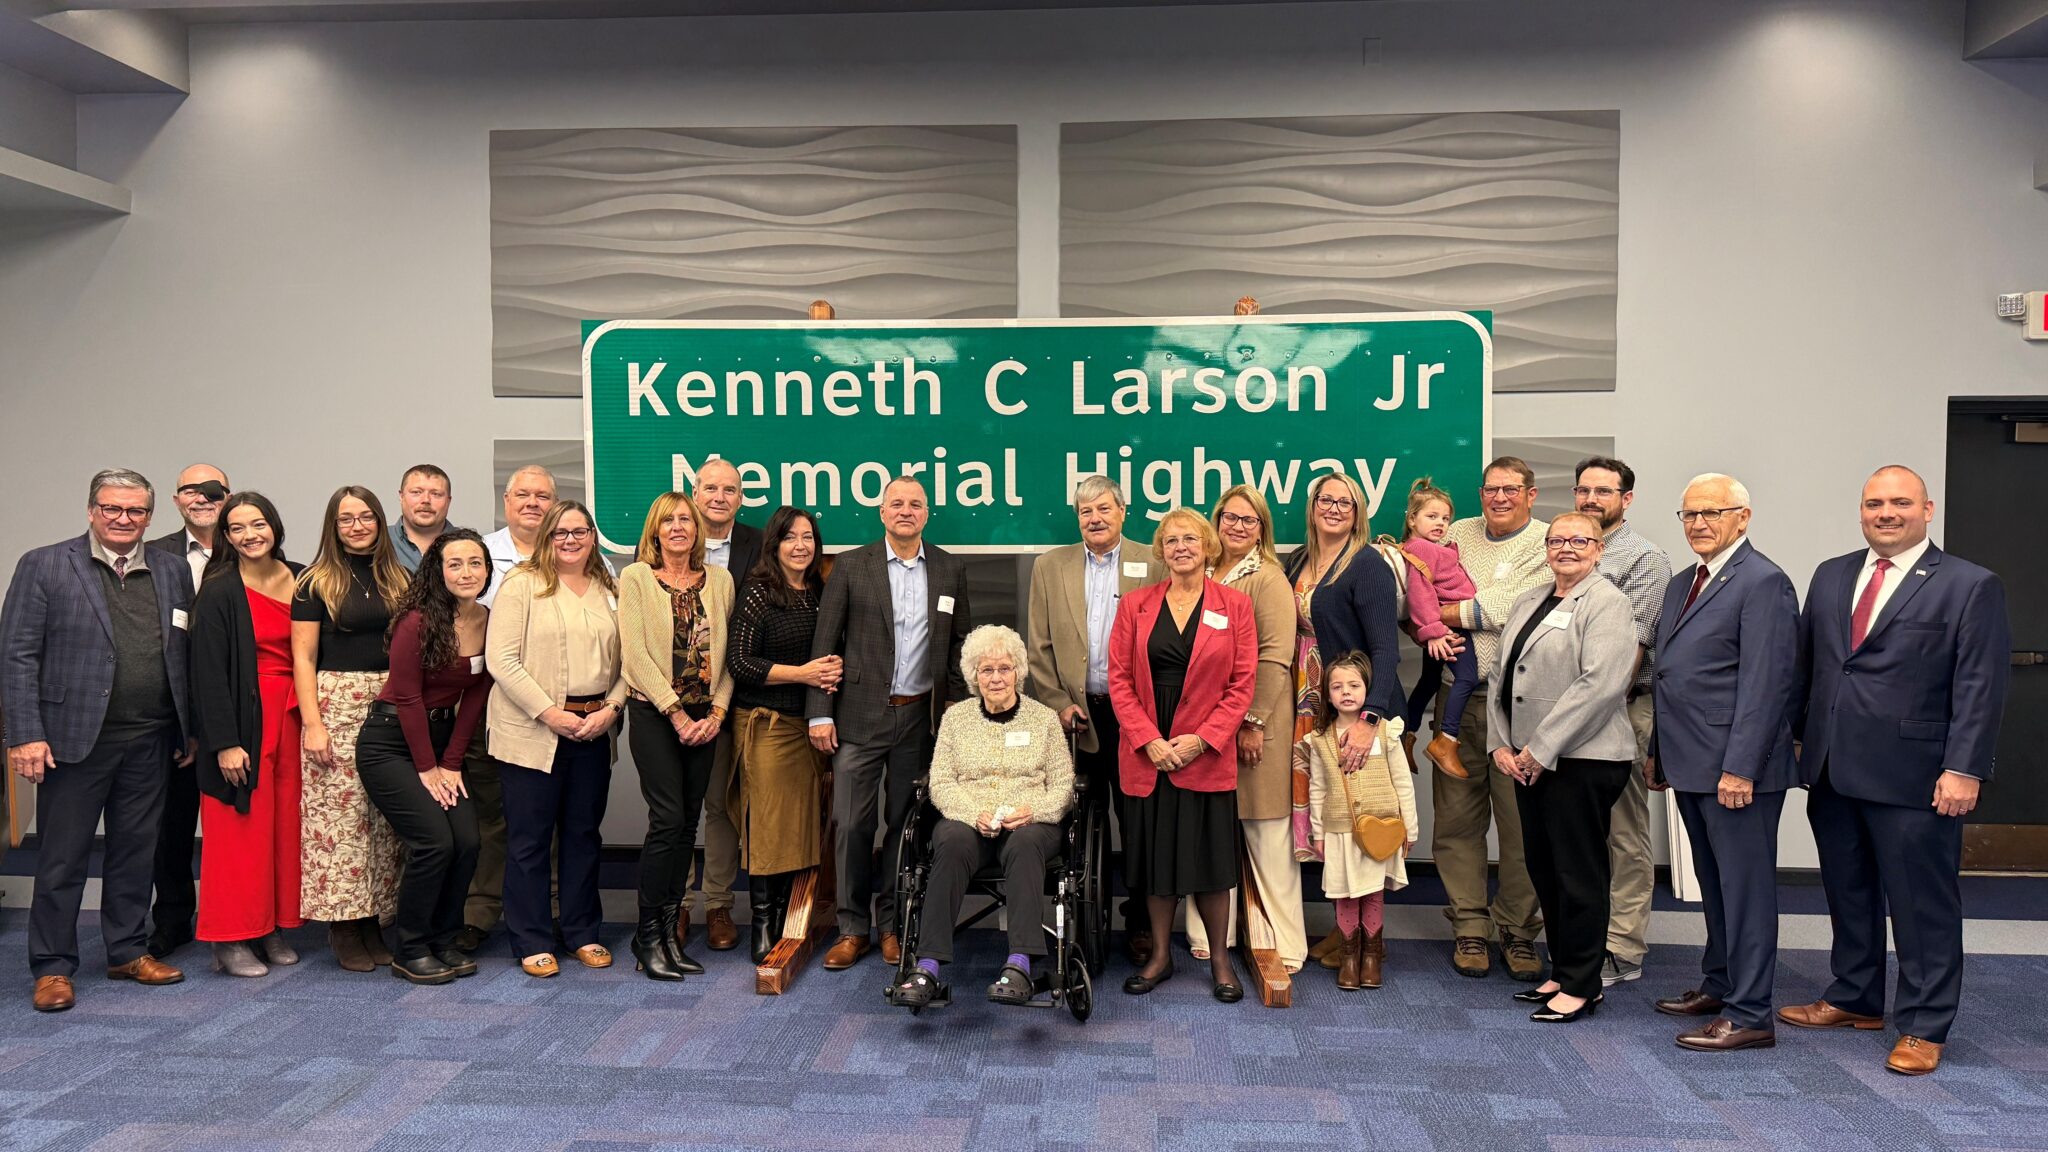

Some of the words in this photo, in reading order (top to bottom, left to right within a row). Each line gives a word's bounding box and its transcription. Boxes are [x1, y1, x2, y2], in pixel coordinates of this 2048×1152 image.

[627, 357, 941, 416] Kenneth
[984, 360, 1028, 415] C
[1072, 361, 1327, 415] Larson
[1374, 354, 1445, 410] Jr
